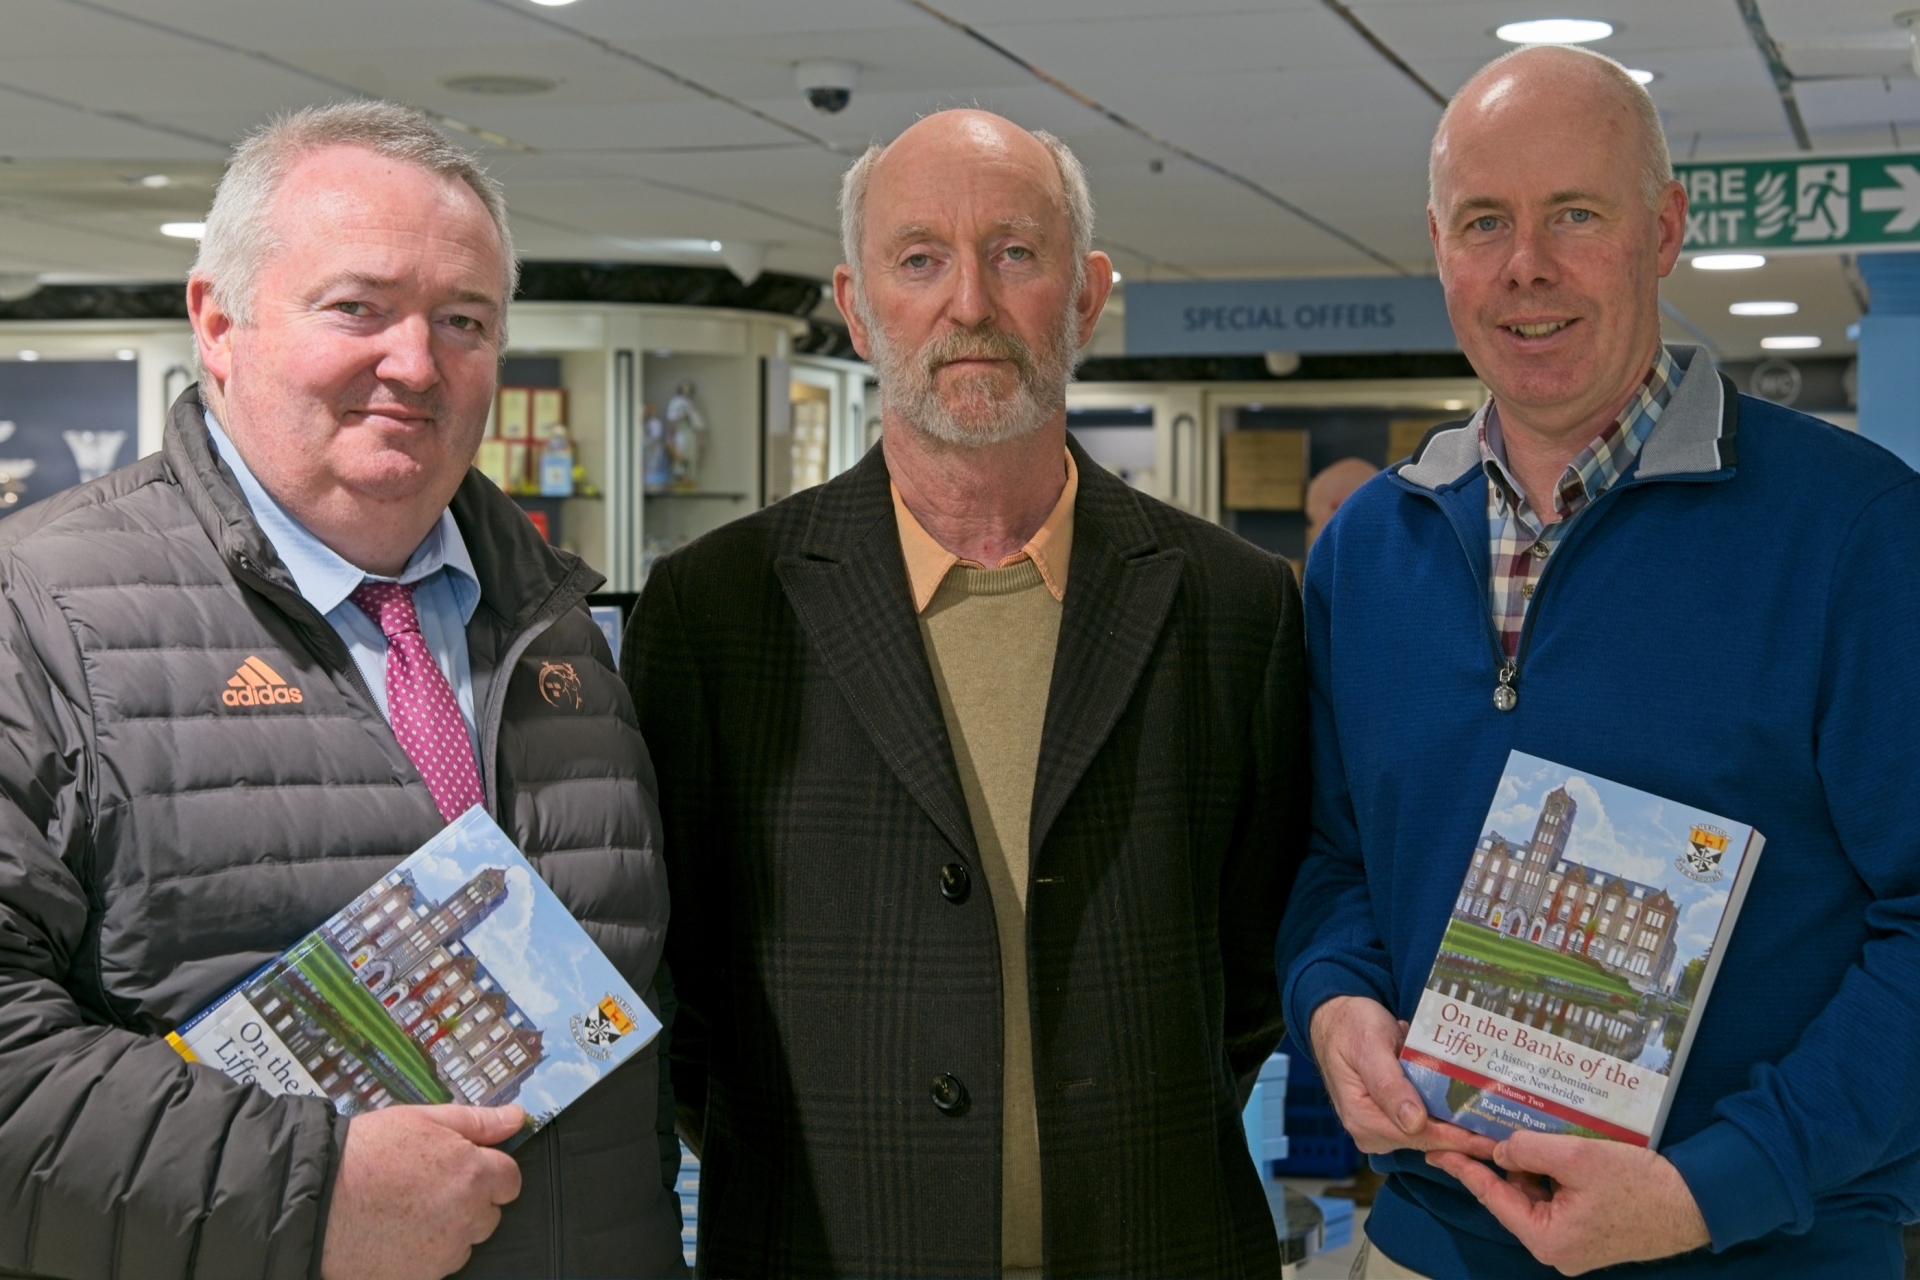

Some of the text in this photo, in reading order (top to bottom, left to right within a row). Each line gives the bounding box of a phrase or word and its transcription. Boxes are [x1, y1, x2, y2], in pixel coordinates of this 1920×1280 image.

[1674, 169, 1746, 203] IRE
[1683, 210, 1746, 244] XIT
[1183, 302, 1395, 332] SPECIAL OFFERS
[222, 684, 303, 706] adidas
[240, 1021, 300, 1094] On the
[1432, 1024, 1489, 1063] Liffey
[1441, 1003, 1640, 1091] On the Banks of the
[214, 1037, 265, 1090] Liffe
[1490, 1048, 1609, 1099] A history of Dominican
[1486, 1061, 1586, 1105] College, Newbridge
[1496, 1083, 1545, 1108] Volume Two
[1481, 1097, 1521, 1120] Raphael
[1521, 1112, 1547, 1130] Ryan
